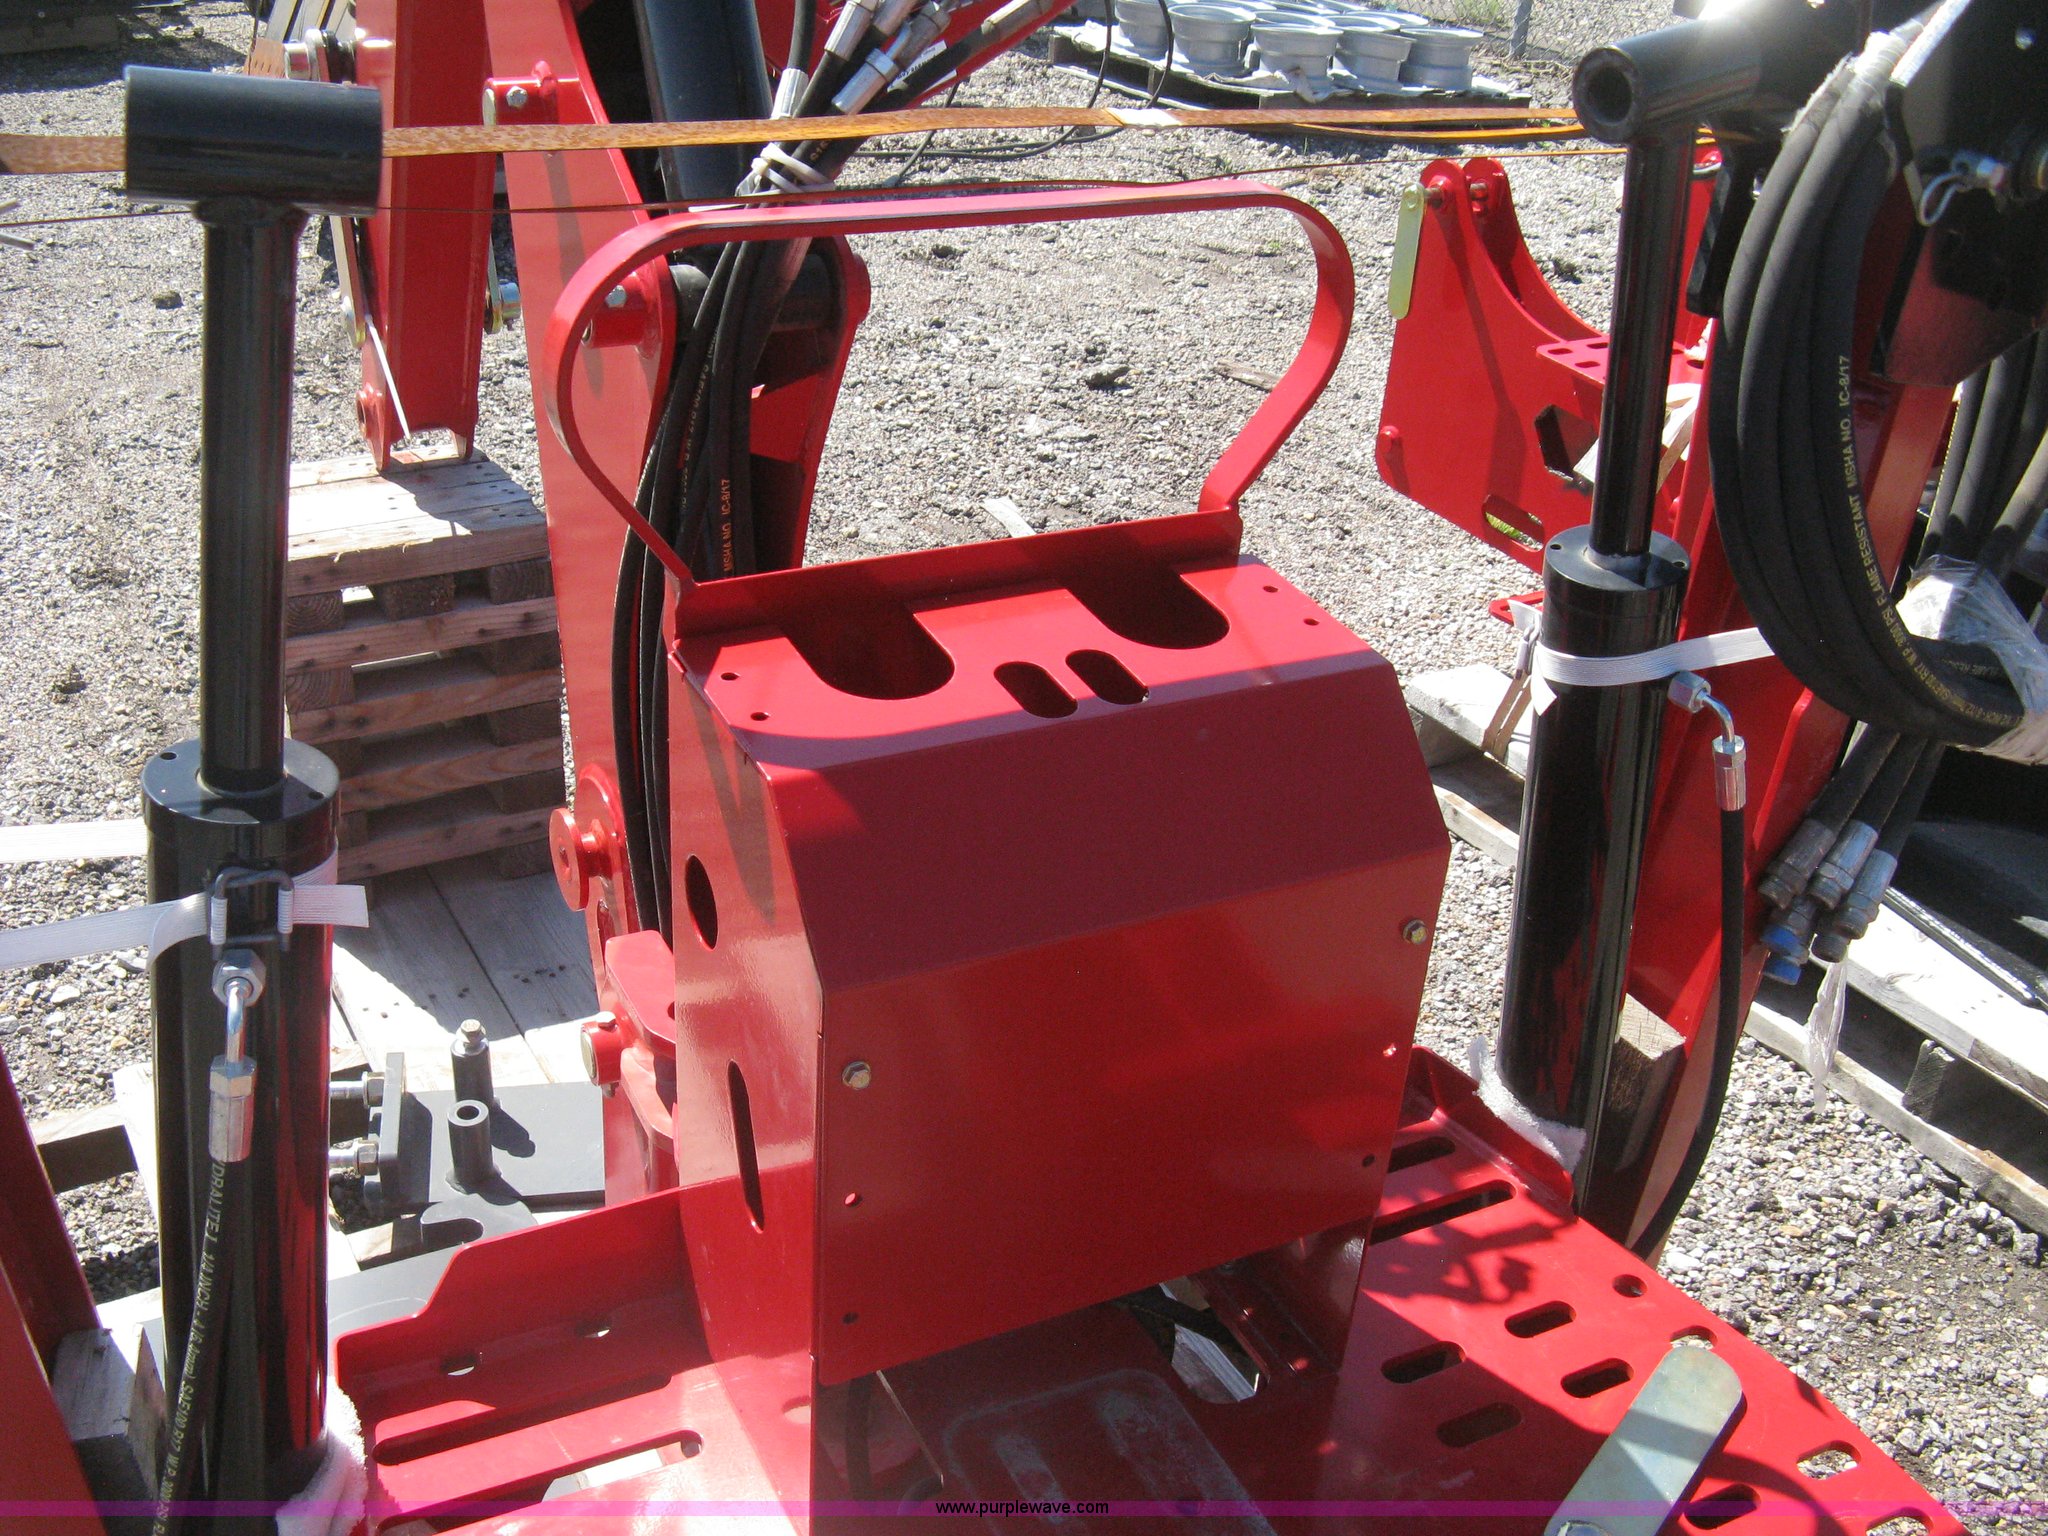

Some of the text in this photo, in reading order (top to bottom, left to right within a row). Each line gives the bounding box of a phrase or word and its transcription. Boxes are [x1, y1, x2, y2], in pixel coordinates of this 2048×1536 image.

[1838, 355, 1850, 407] IC-8/17
[1840, 413, 1852, 442] NO.
[1842, 444, 1858, 488] MSHA
[721, 479, 731, 515] IC-8/17
[1848, 494, 1875, 567] RESISTANT
[1865, 566, 1887, 606] FLAME
[195, 1271, 212, 1310] INCH
